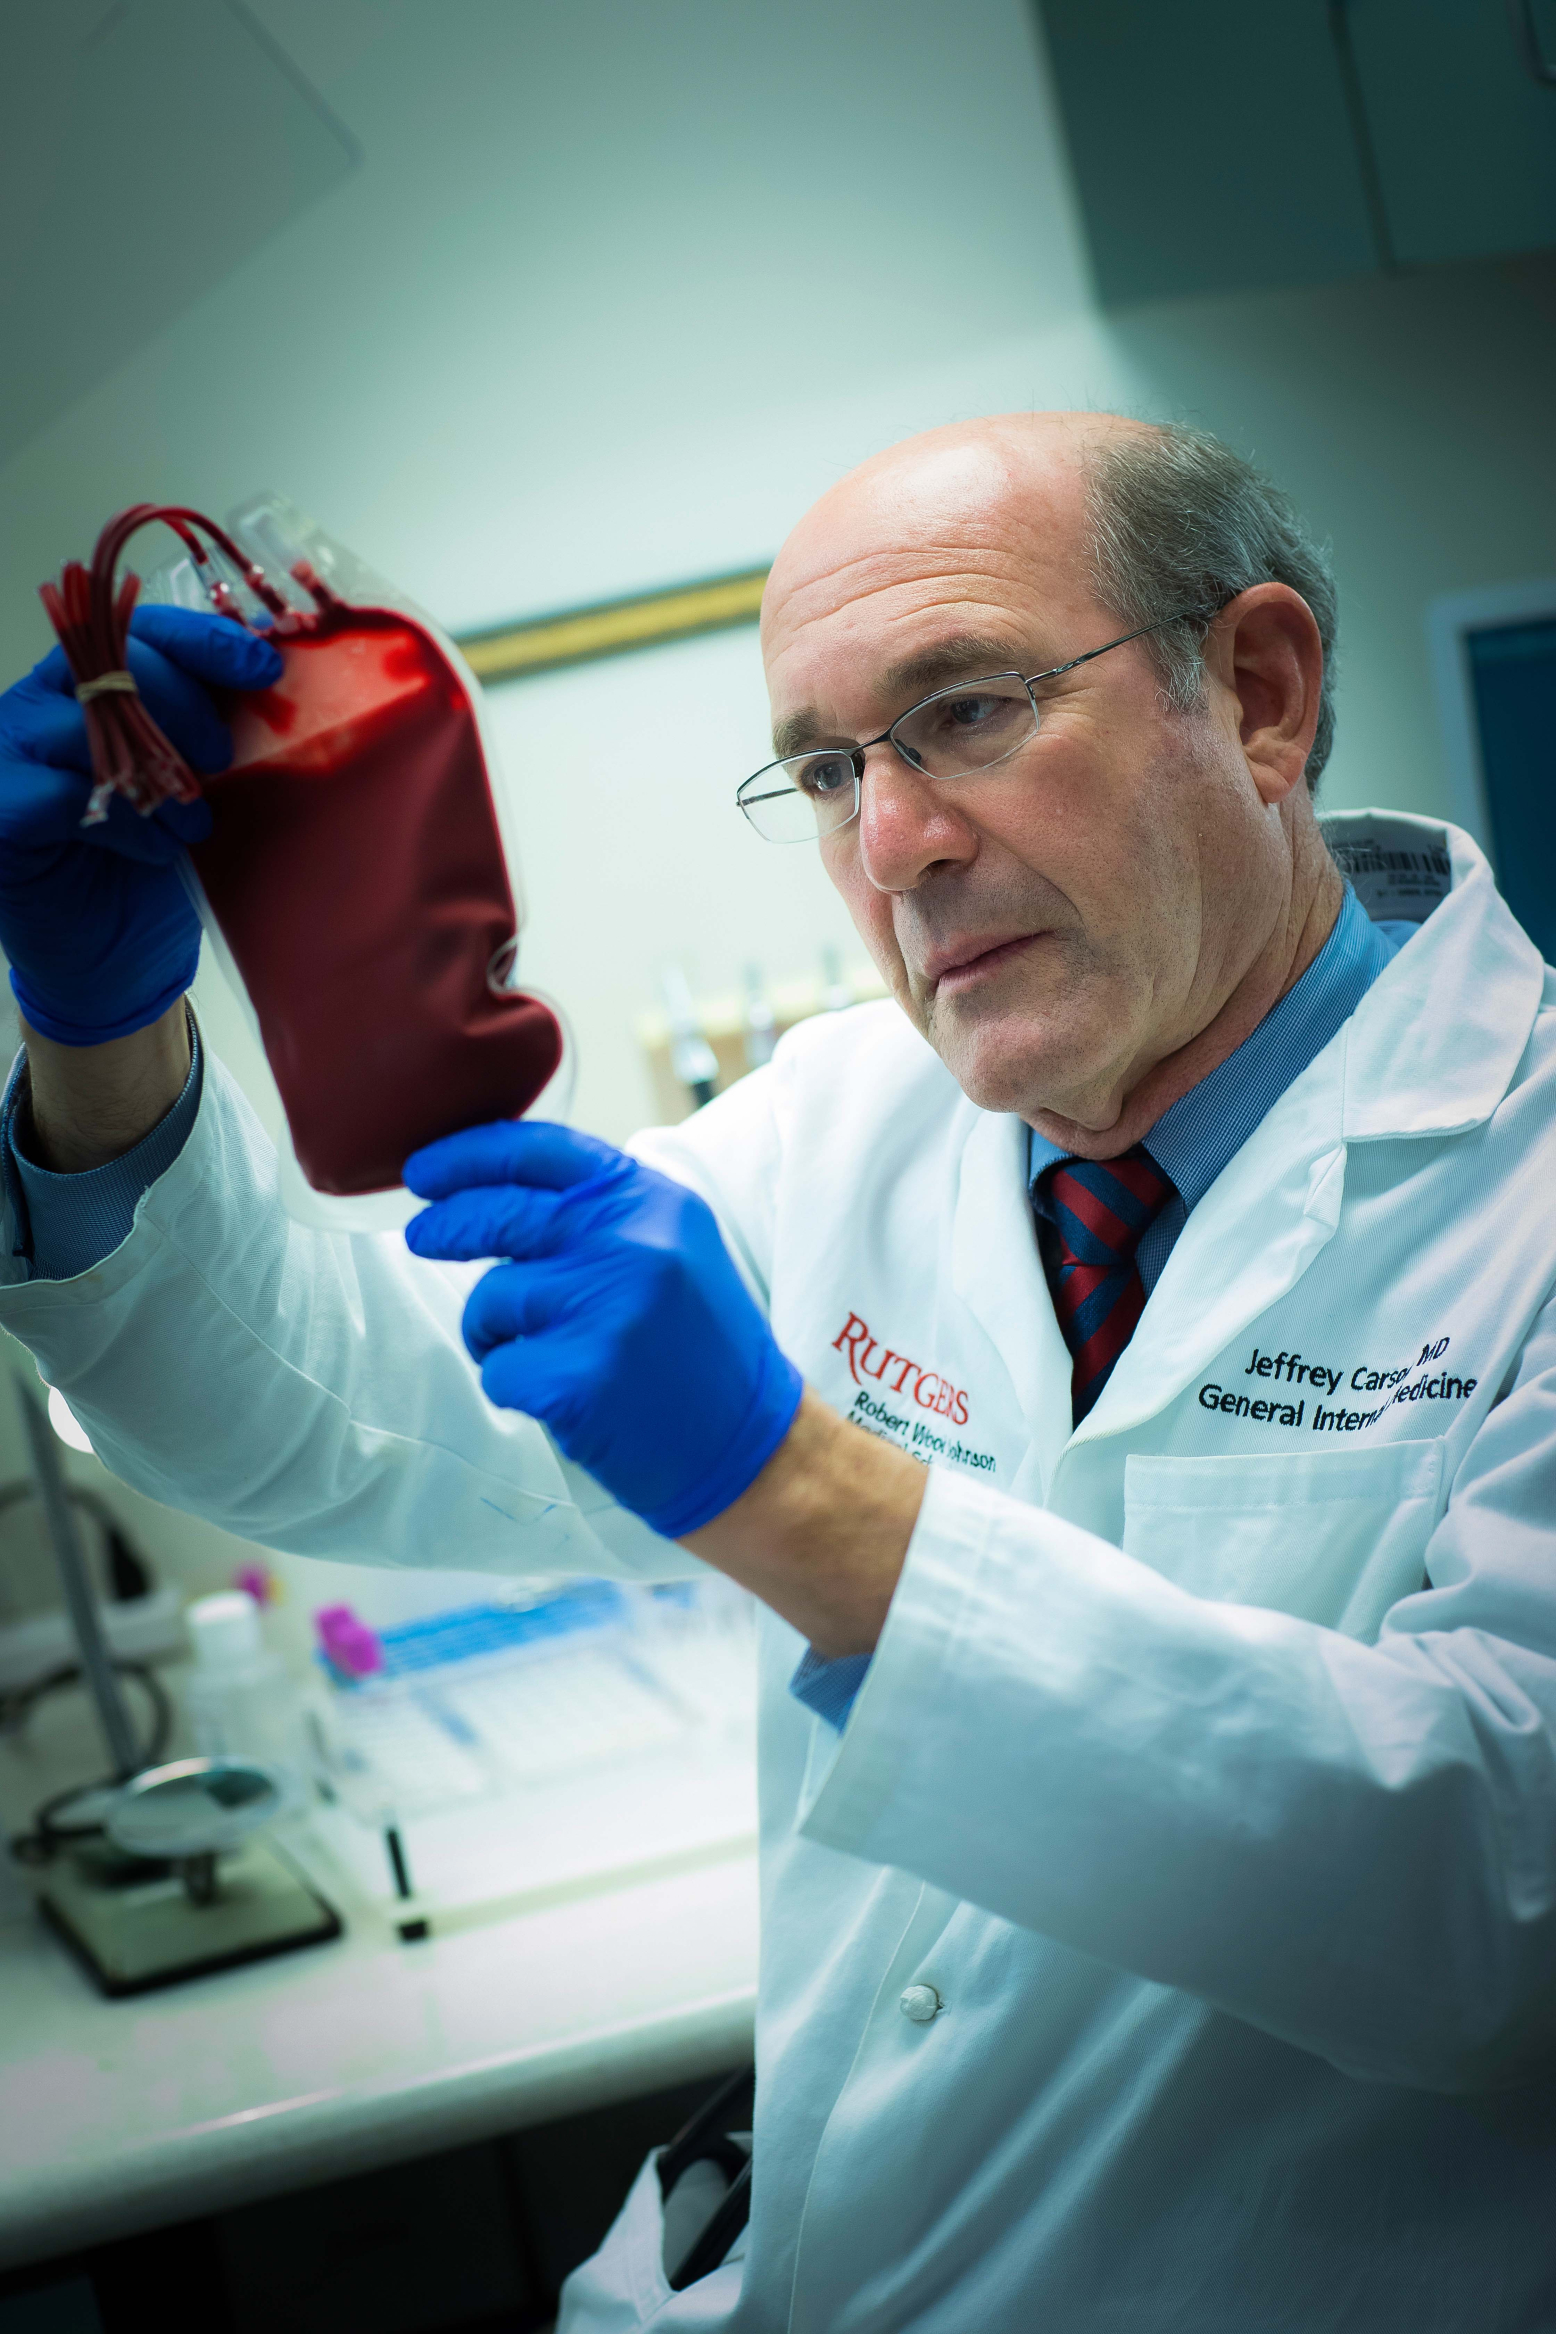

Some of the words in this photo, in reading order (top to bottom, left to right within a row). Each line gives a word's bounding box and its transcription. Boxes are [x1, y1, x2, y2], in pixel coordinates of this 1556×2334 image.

[1245, 1348, 1344, 1396] Jeffrey
[1350, 1366, 1414, 1391] Carso
[1416, 1336, 1450, 1367] MD
[854, 1391, 910, 1436] Robert
[1199, 1383, 1304, 1427] General
